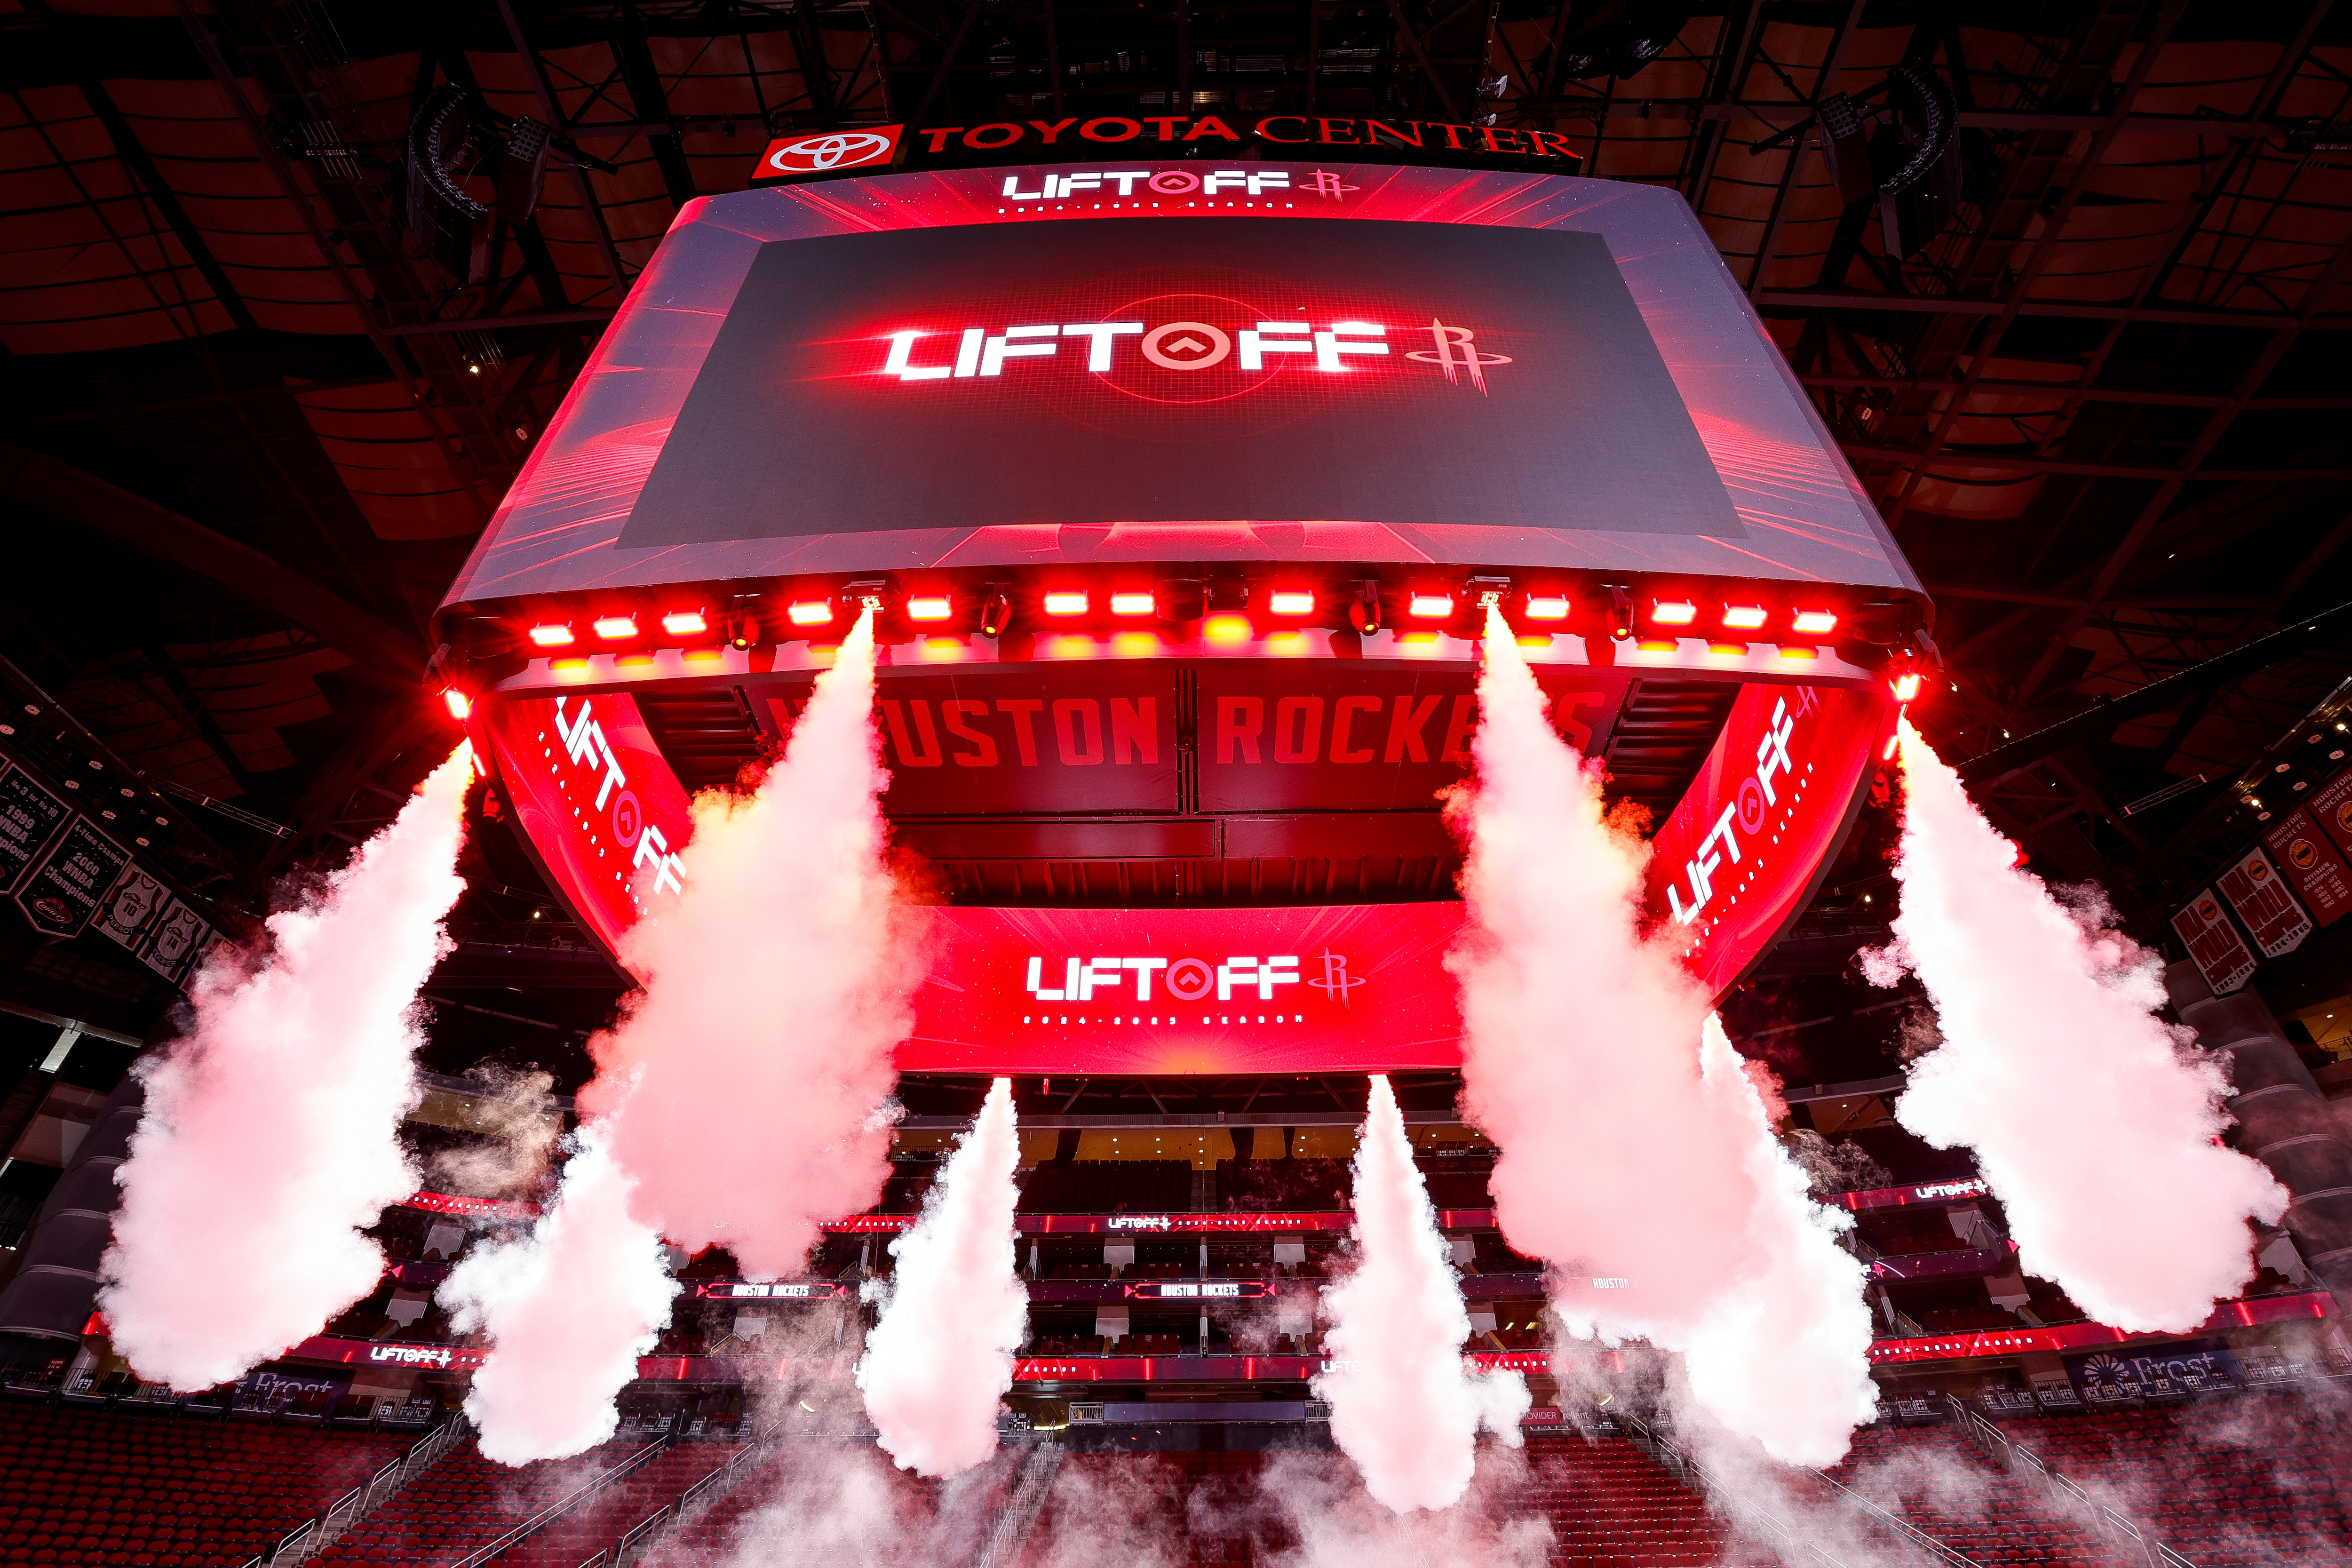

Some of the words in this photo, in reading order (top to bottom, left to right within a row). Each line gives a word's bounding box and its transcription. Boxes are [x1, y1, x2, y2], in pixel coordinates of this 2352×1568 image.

[920, 116, 1240, 152] TOYOTA
[1255, 116, 1584, 159] CENTER
[1002, 170, 1290, 200] LIFTOFF
[885, 322, 1389, 381] LIFTOFF
[767, 697, 1158, 767] USTON
[1216, 692, 1605, 764] ROCKES
[2312, 773, 2352, 807] HOUSTON
[6, 805, 35, 829] 1999
[48, 807, 58, 818] 10
[1667, 696, 1794, 927] LIFTOFF
[2268, 812, 2302, 842] HOUSTON
[2273, 820, 2306, 849] ROCKETS
[75, 823, 98, 845] 4-Time
[98, 842, 124, 866] Champs
[62, 860, 94, 889] WNBA
[72, 852, 100, 876] 2000
[2304, 862, 2330, 883] DIVISION
[45, 865, 96, 907] Champions
[2304, 864, 2337, 891] CHAMPIONS
[123, 902, 138, 917] 10
[107, 914, 134, 934] PERROT
[152, 948, 176, 966] COOPER
[1026, 956, 1299, 1001] LIFTOFF
[1024, 1016, 1176, 1025] 2024-2025
[1203, 1015, 1303, 1025] SEASON
[732, 1285, 770, 1297] HOUSTON
[772, 1285, 810, 1297] ROCKETS
[1161, 1285, 1198, 1297] HOUSTON
[1202, 1284, 1239, 1297] ROCKETS
[1592, 1278, 1630, 1289] HOUSTON
[1321, 1360, 1361, 1373] LIFTO
[2130, 1352, 2214, 1386] Frost
[1520, 1411, 1557, 1420] ROVIDER
[1563, 1411, 1589, 1420] reliant
